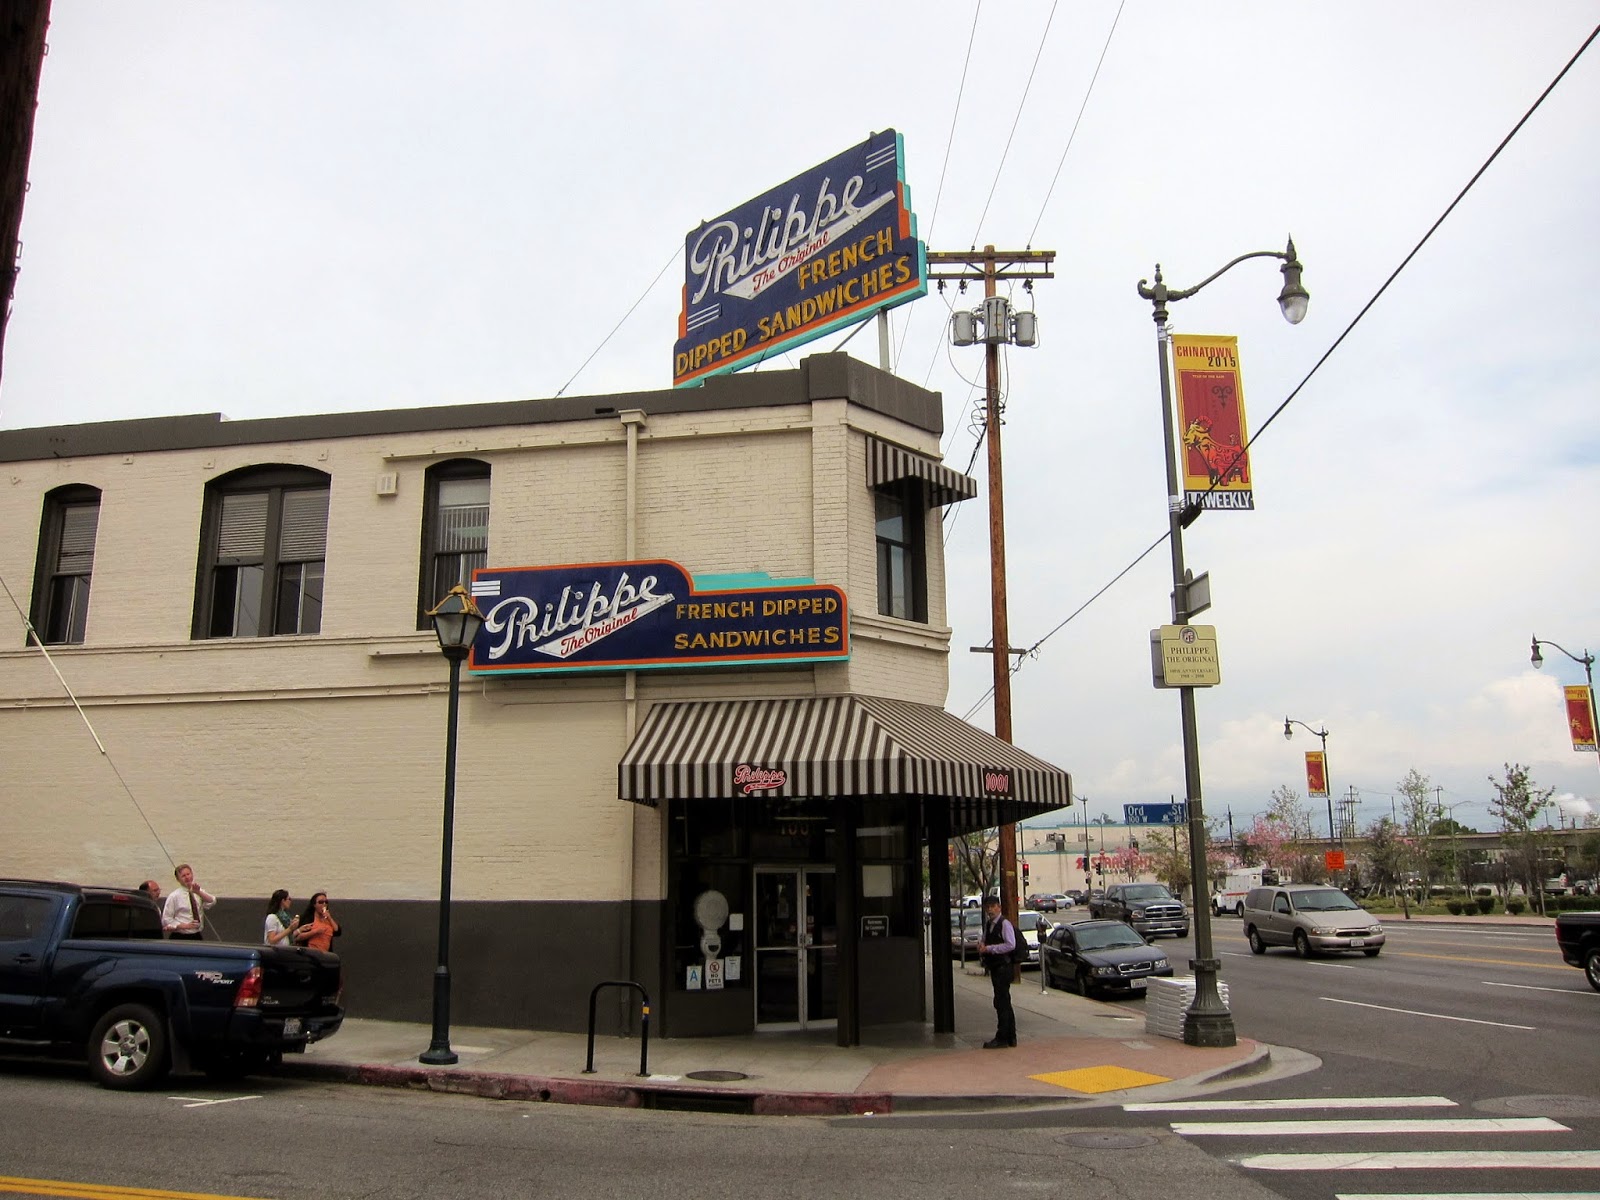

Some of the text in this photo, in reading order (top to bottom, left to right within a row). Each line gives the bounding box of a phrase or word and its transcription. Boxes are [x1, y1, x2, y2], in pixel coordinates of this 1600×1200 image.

[690, 175, 865, 305] Philippe
[752, 231, 830, 292] The Original
[799, 226, 893, 291] FRENCH
[675, 255, 912, 376] DIPPED SANDWICHES
[1176, 346, 1233, 358] CHINATOWN
[1208, 357, 1236, 368] 2015
[1205, 491, 1250, 508] WEEKLY
[484, 572, 659, 660] Philippe
[676, 597, 838, 620] FRENCH DIPPED
[560, 608, 638, 656] The Original
[674, 626, 840, 650] SANDWICHES
[1170, 647, 1210, 655] PHILIPPE
[985, 772, 1009, 793] 1001
[1128, 804, 1182, 816] Ord St
[1142, 815, 1148, 823] W
